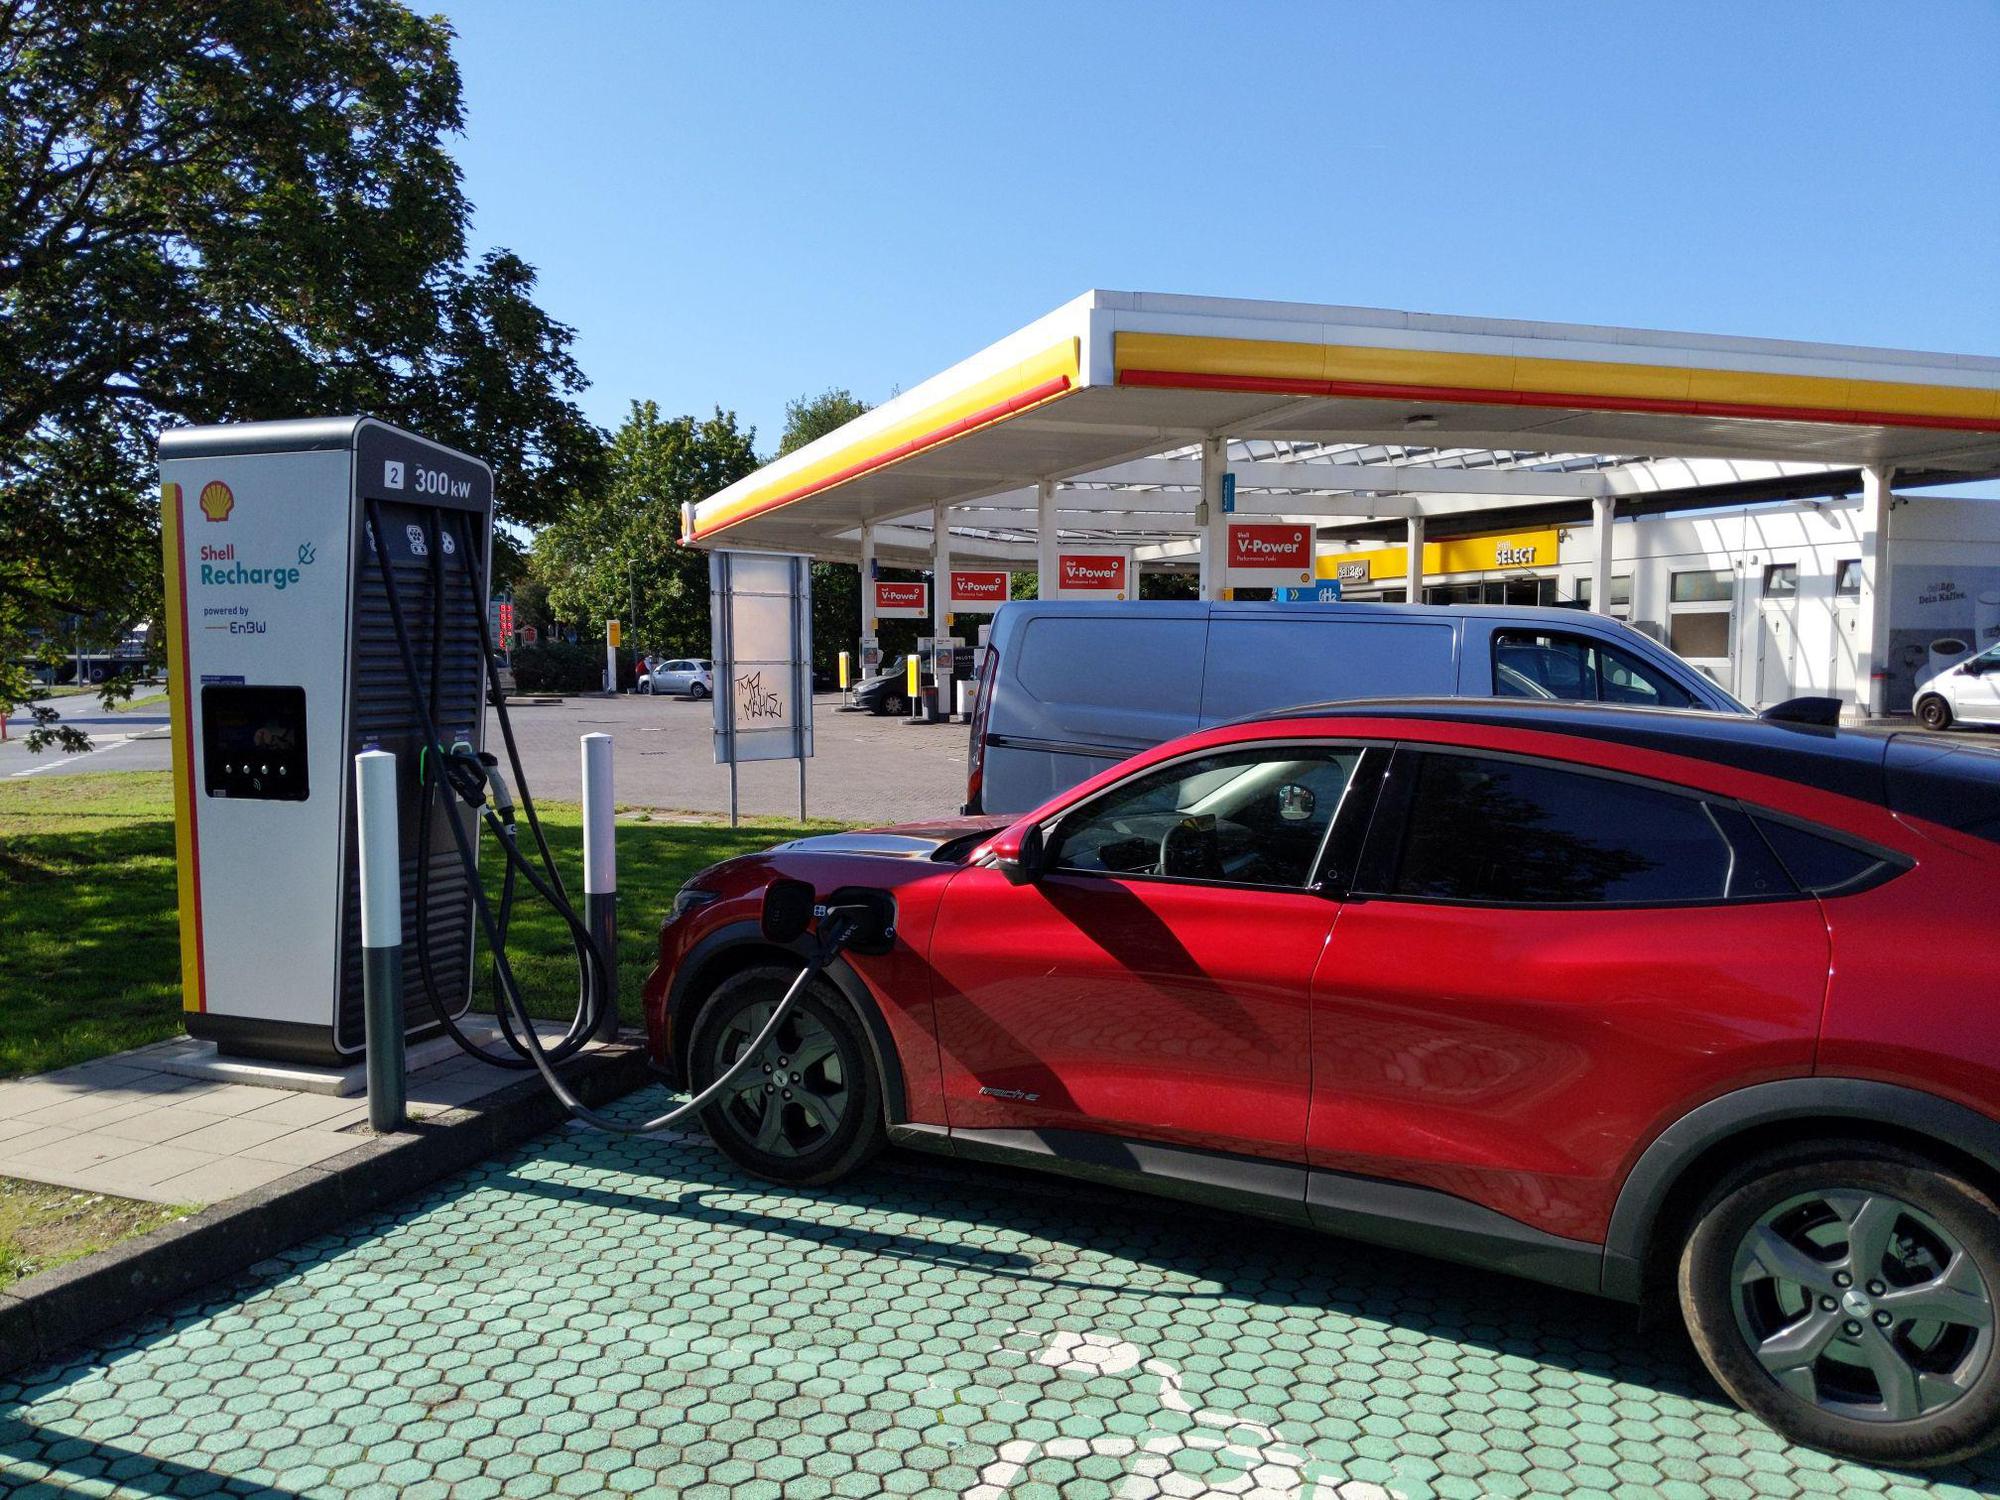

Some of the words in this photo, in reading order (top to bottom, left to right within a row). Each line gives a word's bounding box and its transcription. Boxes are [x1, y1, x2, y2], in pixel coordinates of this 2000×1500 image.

[390, 467, 399, 484] 2
[415, 468, 449, 496] 300
[450, 480, 472, 499] kW
[201, 544, 234, 561] Shell
[1237, 539, 1300, 553] V-Power
[1496, 547, 1536, 565] SELECT
[201, 562, 300, 590] Recharge
[1066, 566, 1117, 578] V-Power
[957, 582, 999, 591] V-Power
[203, 606, 238, 617] powered
[239, 605, 249, 617] by
[229, 621, 267, 635] EnBW
